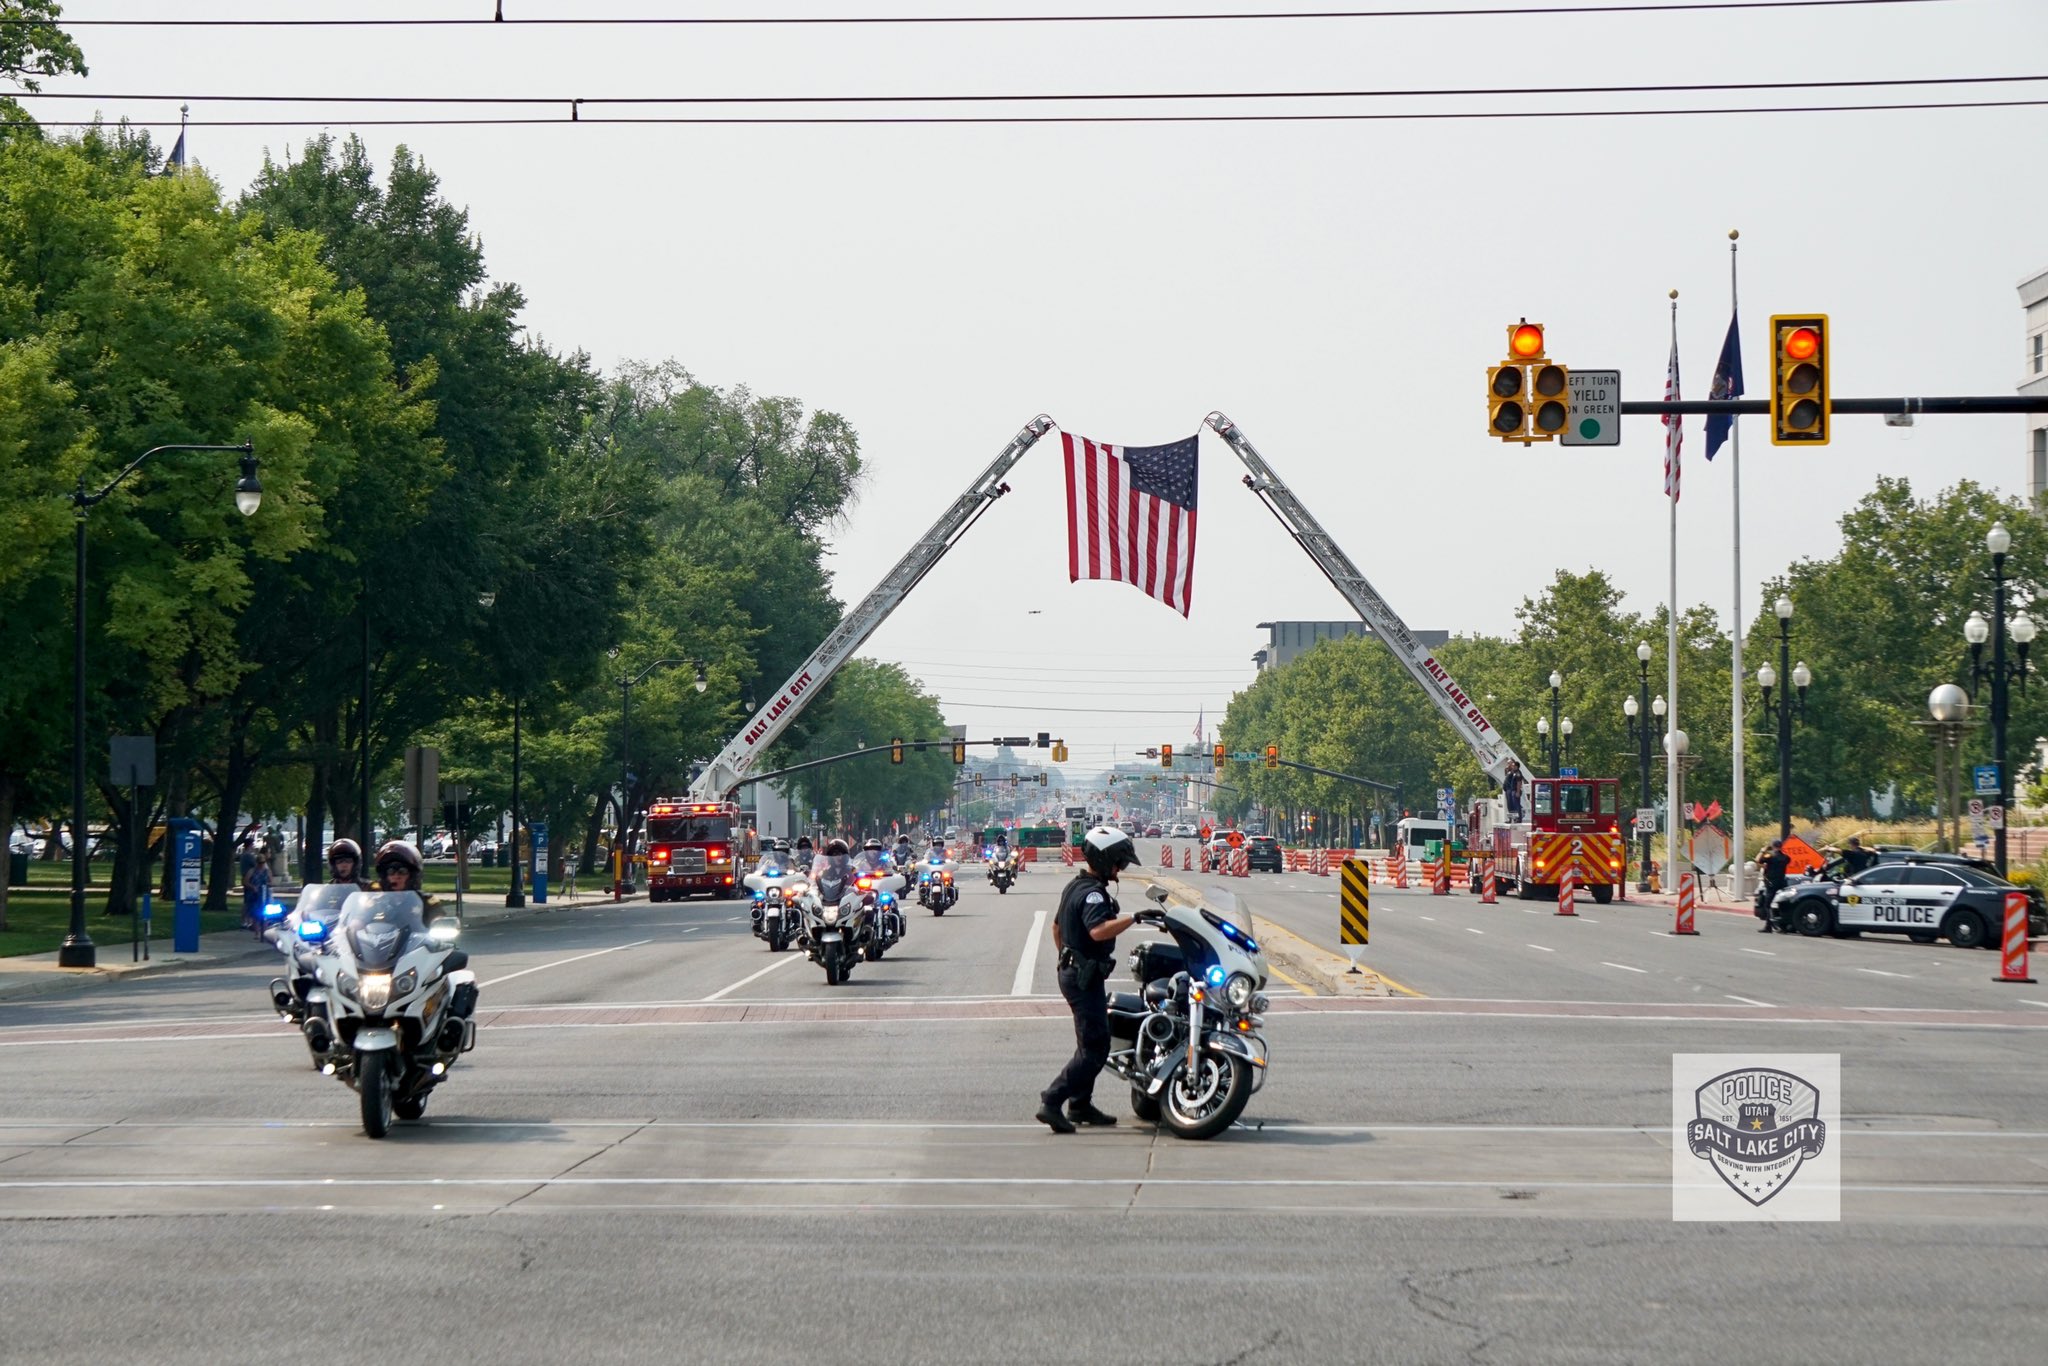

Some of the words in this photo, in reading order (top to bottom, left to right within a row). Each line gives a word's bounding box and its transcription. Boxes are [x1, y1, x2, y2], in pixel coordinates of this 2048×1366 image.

[1568, 376, 1585, 386] EFT
[1591, 376, 1617, 386] TURN
[1573, 389, 1606, 401] YIELD
[1583, 404, 1614, 414] GREEN
[1423, 657, 1449, 682] SALT
[1444, 682, 1470, 709] LAKE
[1467, 708, 1490, 733] CITY
[744, 719, 768, 746] SALT
[766, 694, 792, 721] LAKE
[789, 671, 812, 697] CITY
[1638, 820, 1654, 829] 30
[184, 842, 194, 854] P
[1570, 839, 1583, 855] 2
[1873, 905, 1935, 924] POLICE
